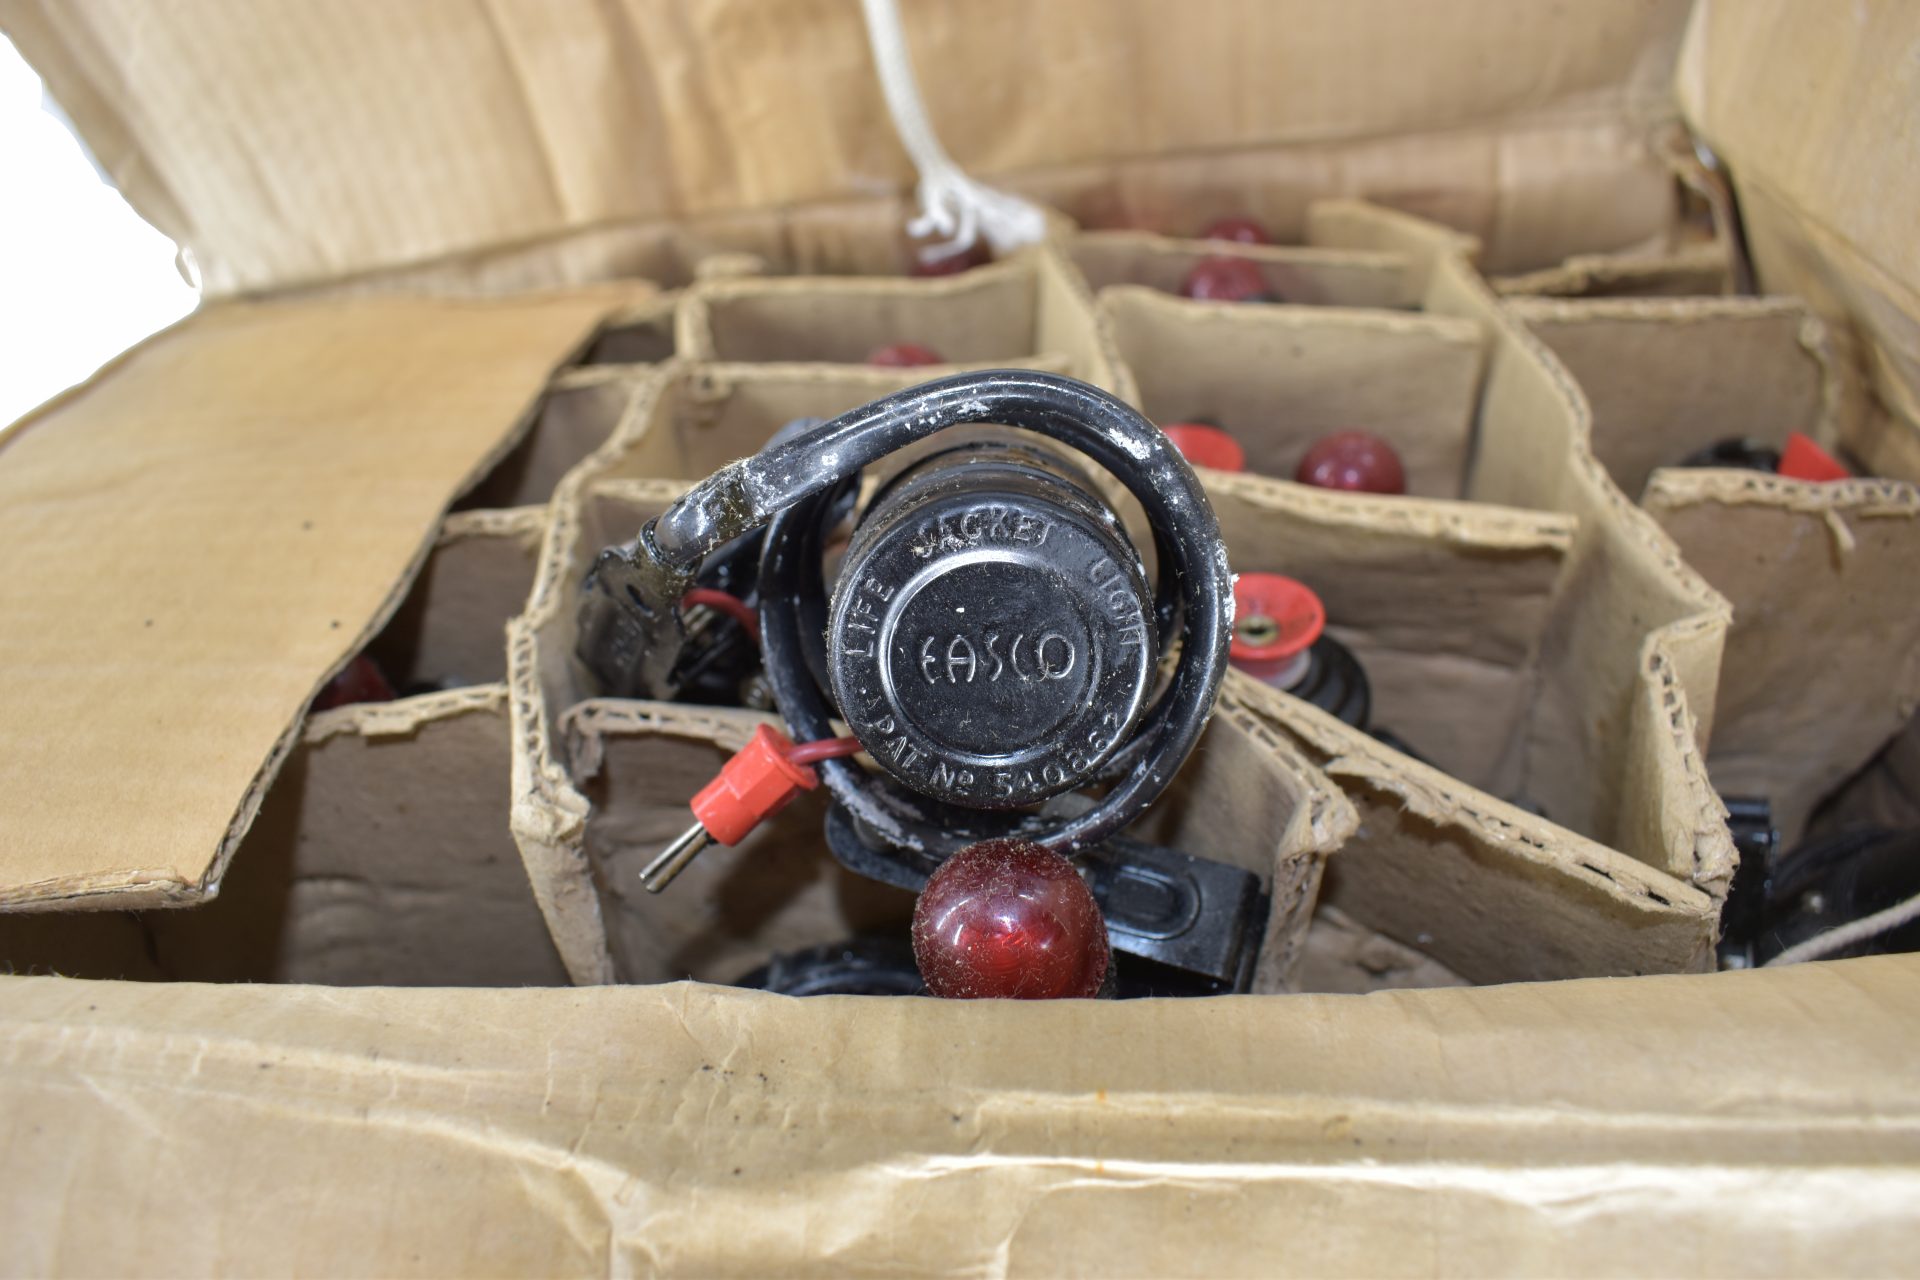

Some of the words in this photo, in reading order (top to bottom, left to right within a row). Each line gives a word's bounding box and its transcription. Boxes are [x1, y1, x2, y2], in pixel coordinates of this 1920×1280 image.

[844, 577, 895, 658] LIFE
[914, 507, 1057, 558] JACKET
[1090, 558, 1144, 645] LIGHT
[920, 633, 1076, 685] EASCO
[862, 714, 928, 769] PAT
